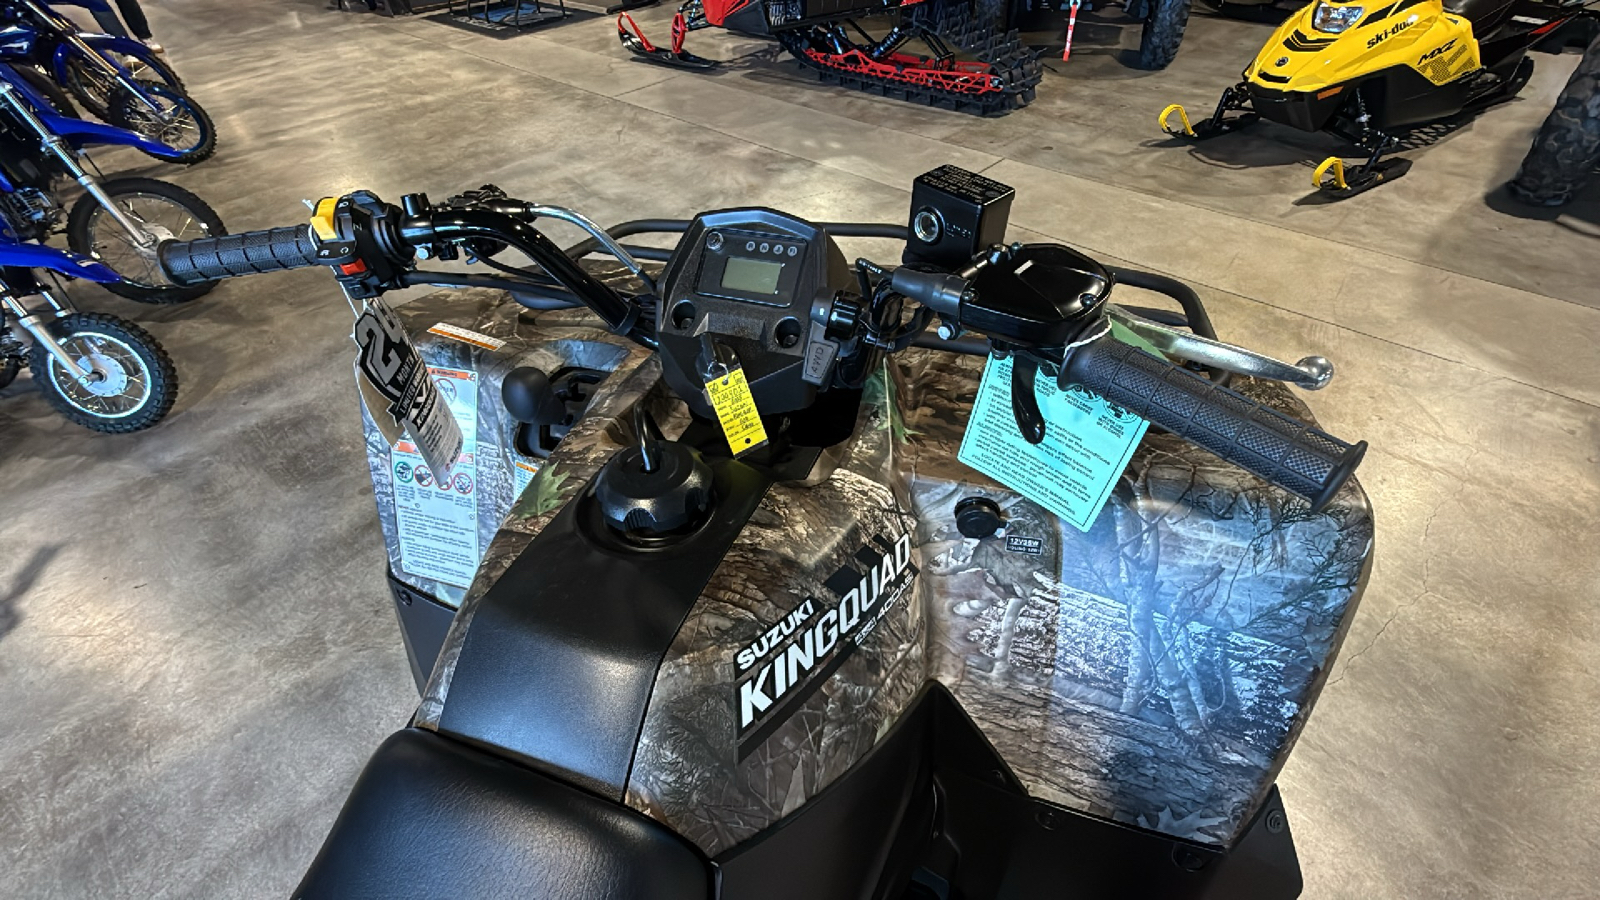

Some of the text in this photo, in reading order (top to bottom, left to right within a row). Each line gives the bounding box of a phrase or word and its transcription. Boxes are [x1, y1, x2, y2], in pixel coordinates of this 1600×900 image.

[1418, 38, 1458, 65] MXZ
[736, 600, 814, 671] SUZUKI
[740, 532, 911, 729] KINGQUAD
